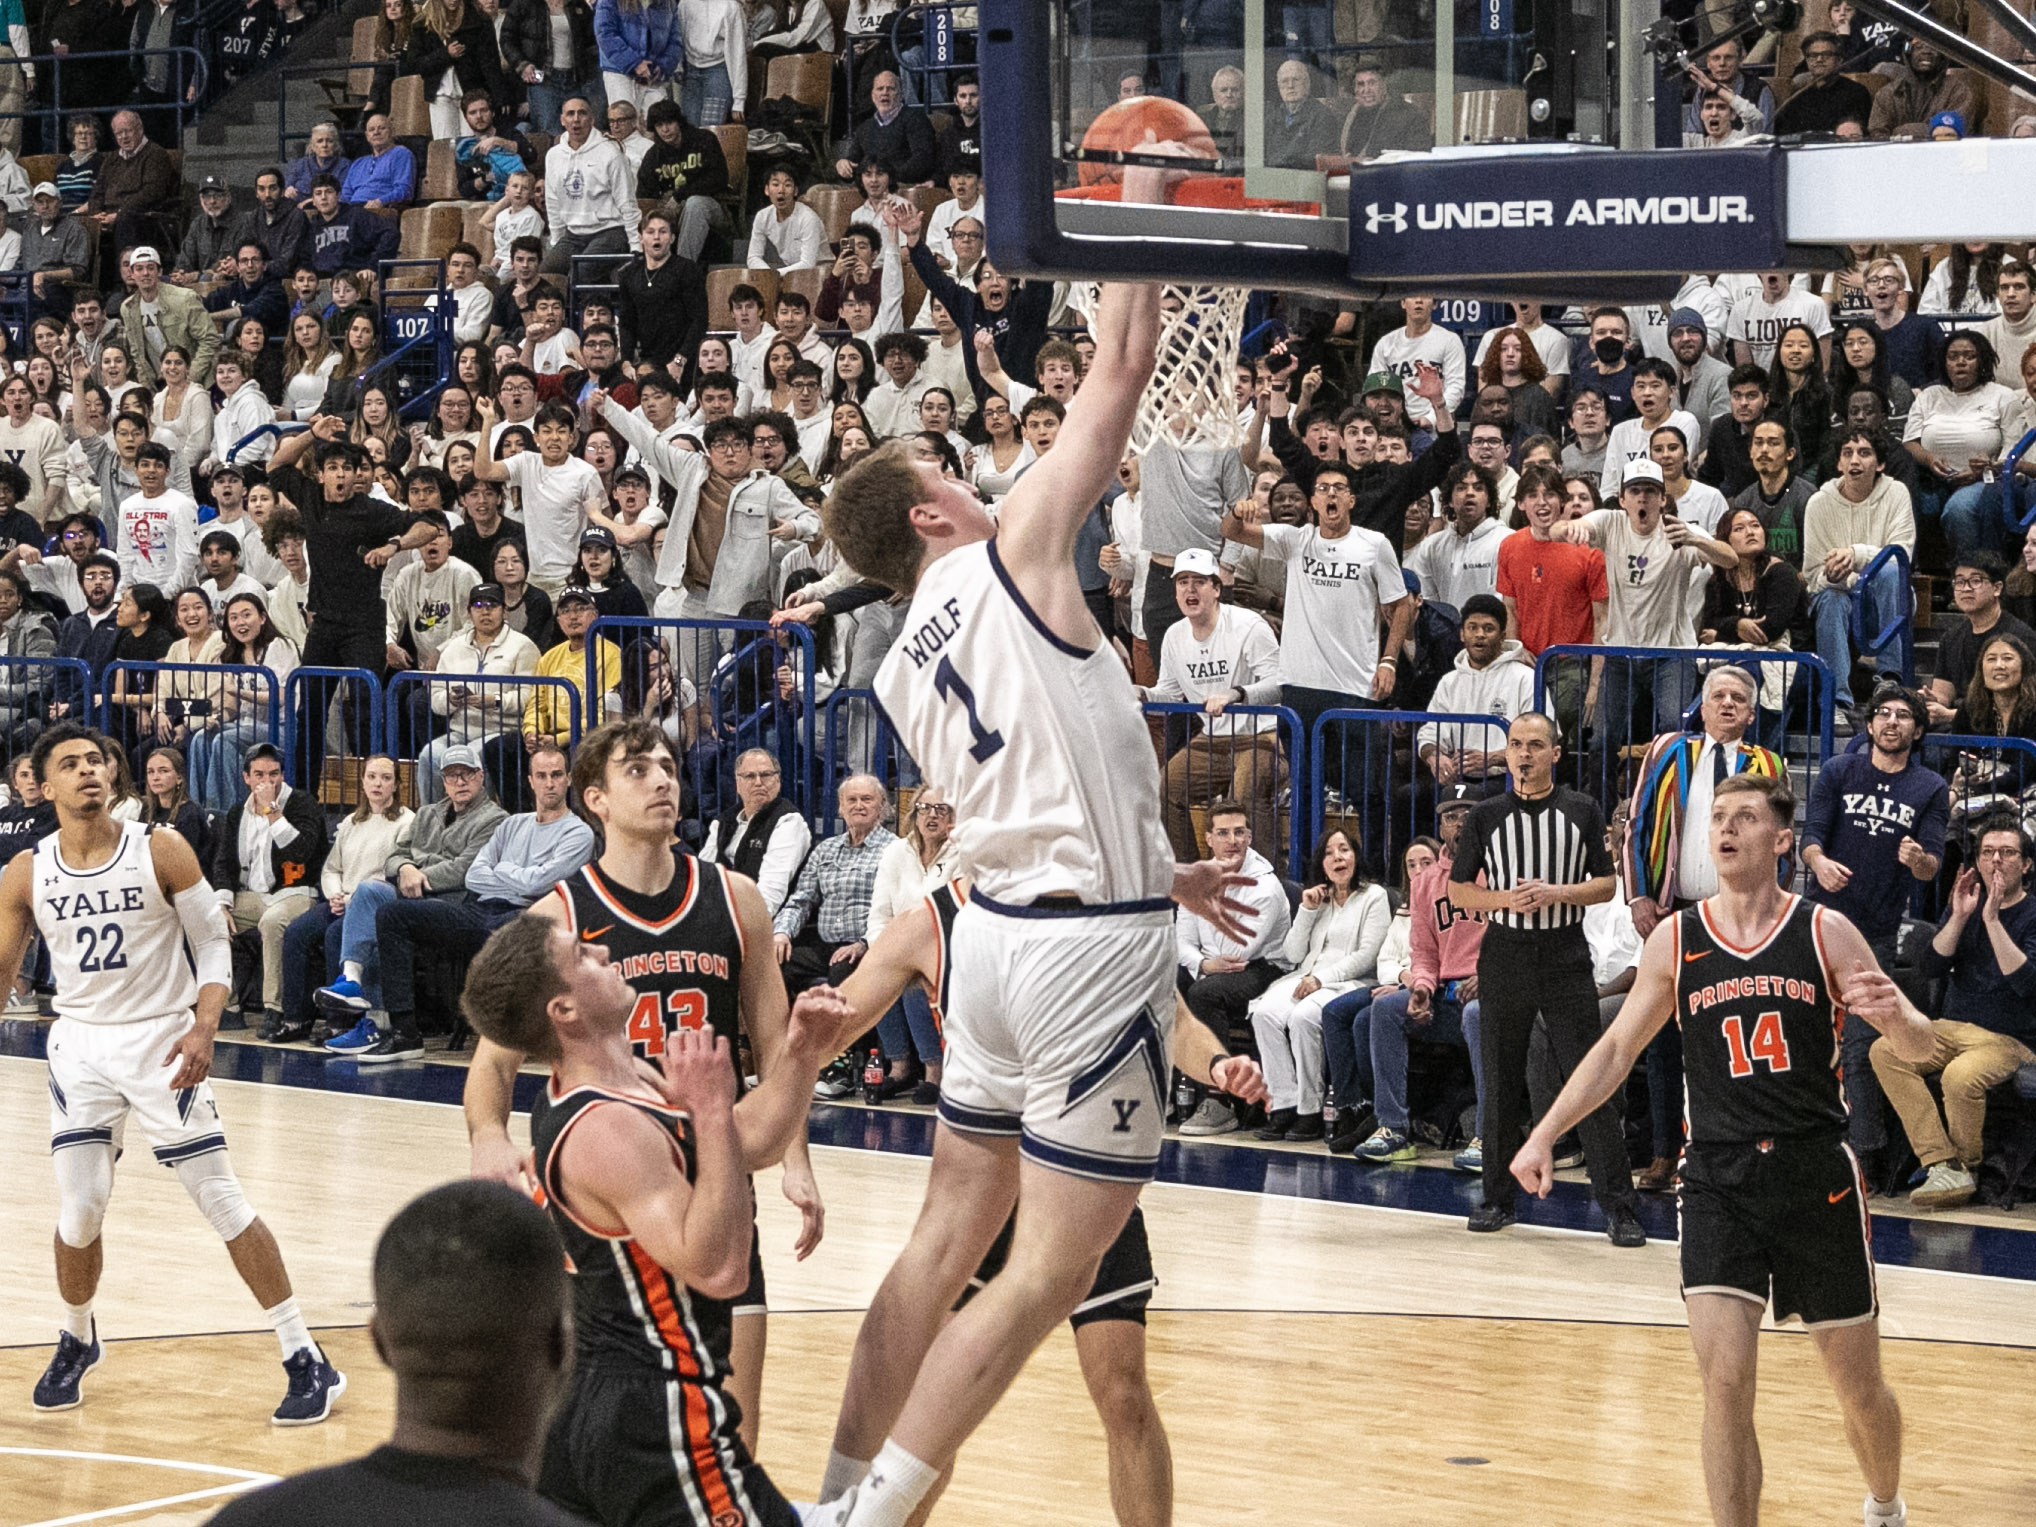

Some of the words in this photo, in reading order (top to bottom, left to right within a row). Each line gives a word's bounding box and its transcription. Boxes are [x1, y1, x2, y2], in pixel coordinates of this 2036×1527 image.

[223, 36, 251, 55] 207
[936, 14, 947, 61] 208
[1415, 200, 1554, 230] UNDER
[1440, 299, 1481, 322] 109
[396, 317, 429, 338] 107
[1303, 556, 1361, 580] YALE
[1311, 577, 1342, 588] TENNIS
[902, 597, 961, 669] WOLF
[1186, 659, 1229, 679] YALE
[934, 653, 1006, 765] 1
[1454, 784, 1467, 799] 7
[1842, 793, 1916, 829] YALE
[1866, 817, 1885, 836] Y
[47, 886, 144, 921] YALE
[76, 922, 128, 973] 22
[611, 950, 729, 980] INCETON
[1688, 975, 1815, 1016] PRINCETON
[625, 987, 708, 1058] 43
[1721, 1011, 1792, 1079] 14
[1111, 1099, 1141, 1132] Y
